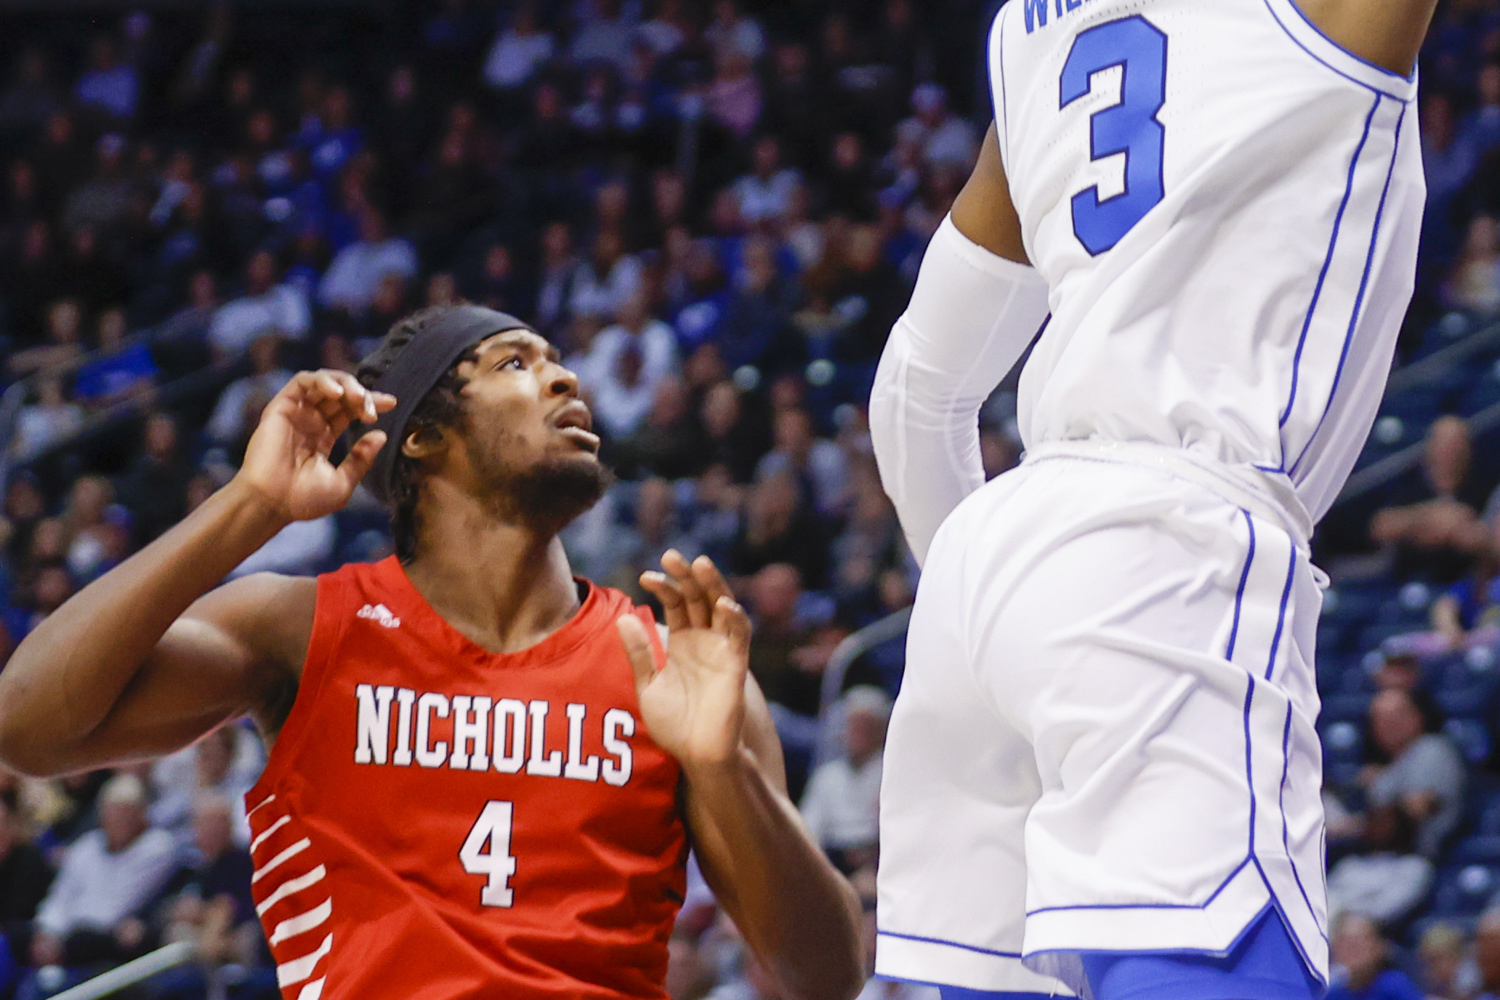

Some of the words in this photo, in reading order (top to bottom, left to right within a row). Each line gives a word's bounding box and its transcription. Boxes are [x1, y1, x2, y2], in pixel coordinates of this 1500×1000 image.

[1058, 14, 1168, 257] 3
[353, 683, 635, 787] NICHOLLS
[458, 799, 516, 908] 4
